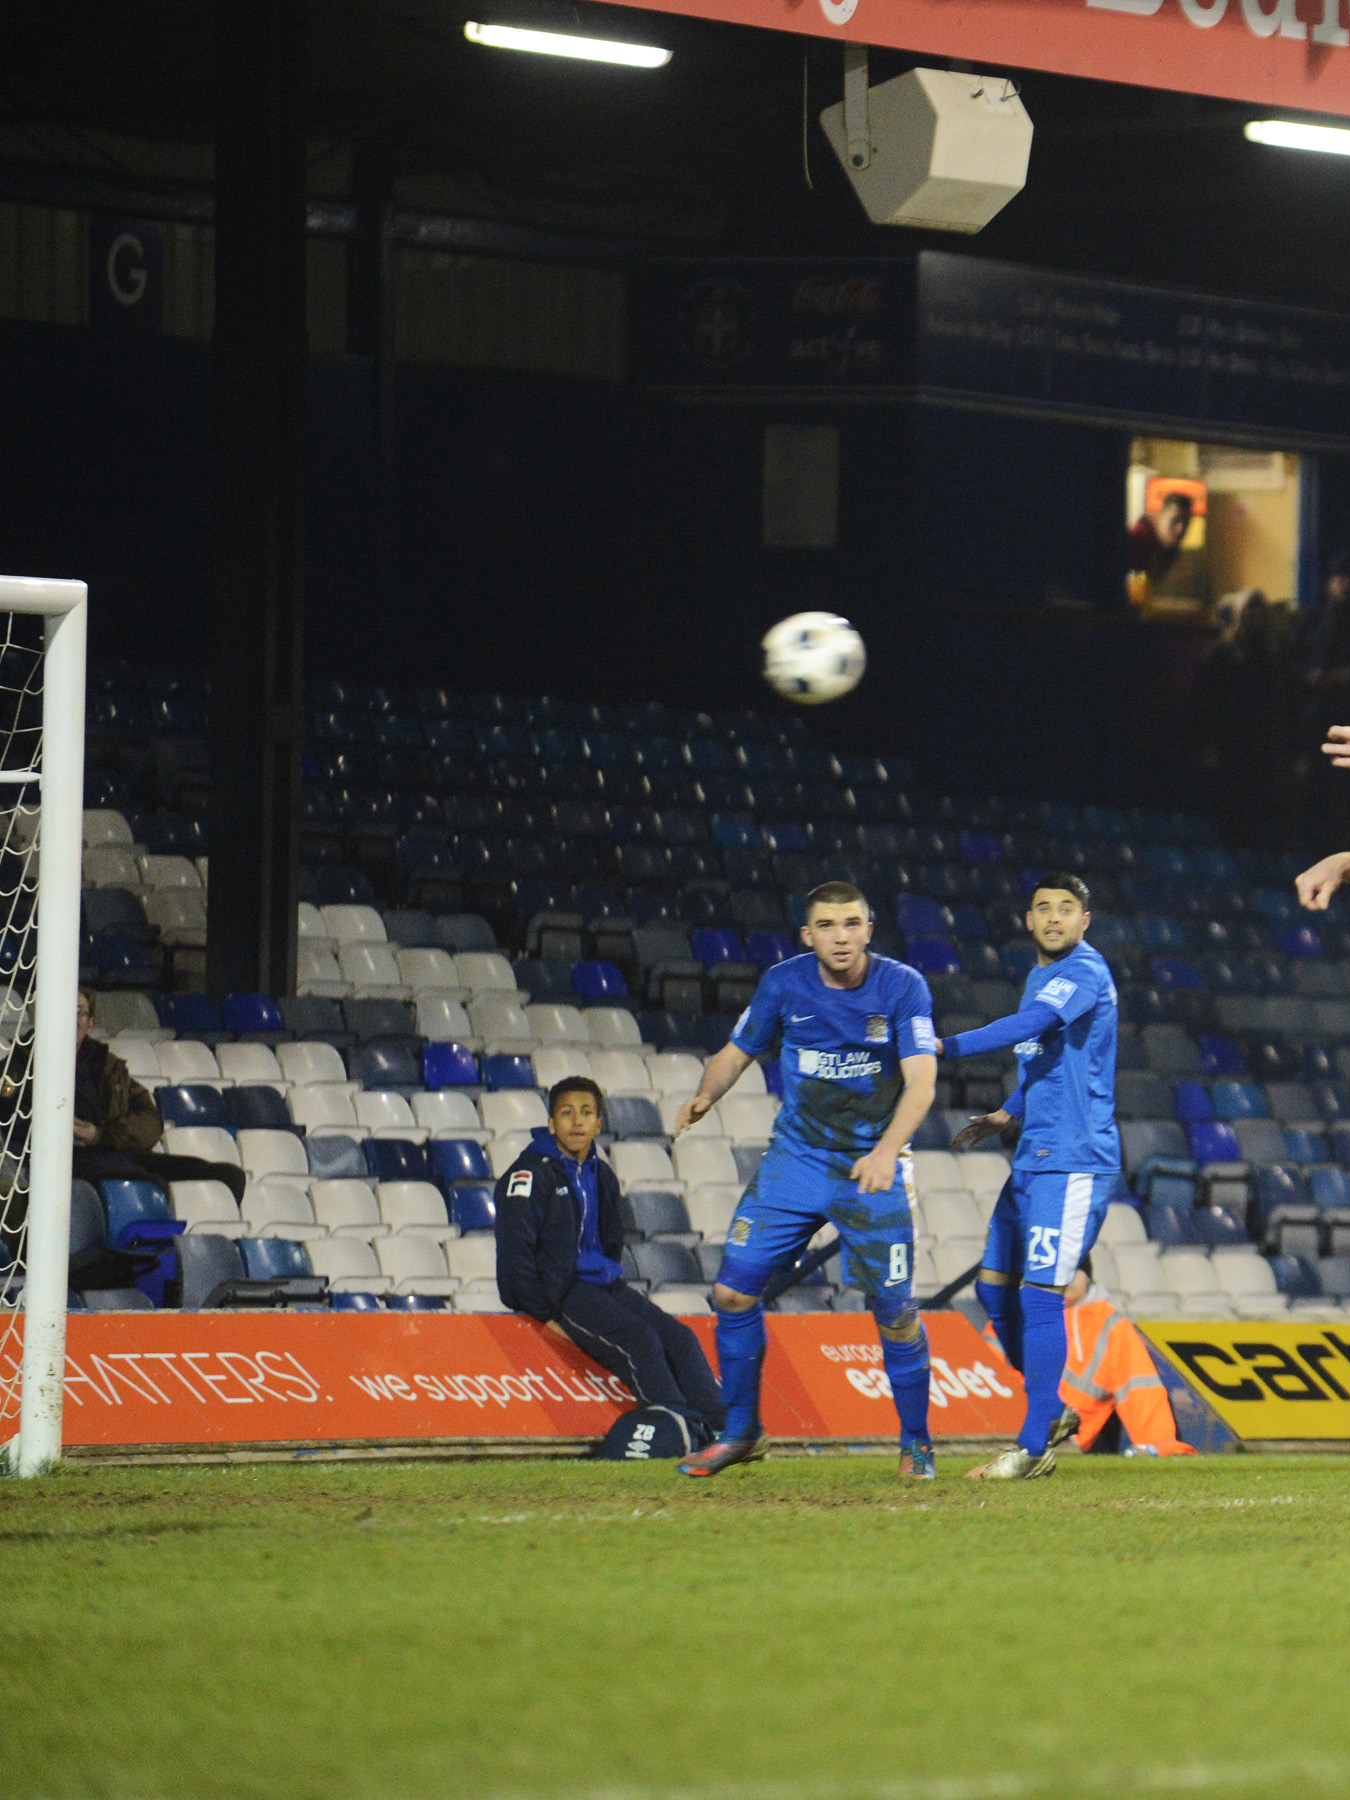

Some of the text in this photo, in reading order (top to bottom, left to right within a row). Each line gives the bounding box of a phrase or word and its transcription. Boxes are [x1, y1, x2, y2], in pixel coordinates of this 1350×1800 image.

[107, 232, 148, 306] G
[889, 1243, 908, 1280] 8
[1028, 1226, 1060, 1265] 25
[350, 1374, 417, 1401] we
[414, 1368, 543, 1409] support
[845, 1357, 1013, 1408] eaJet
